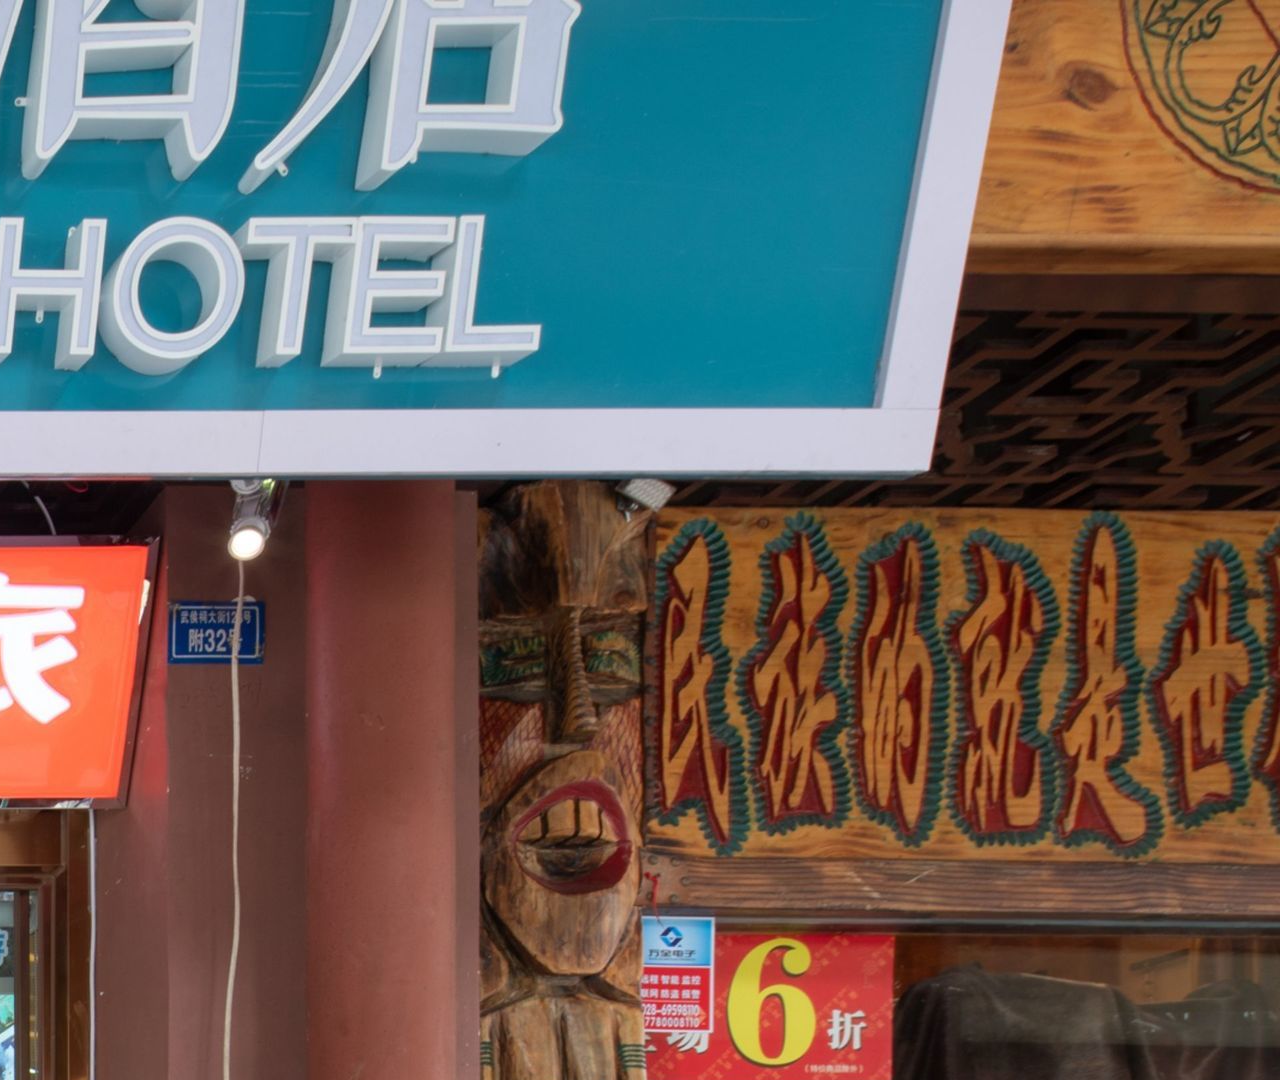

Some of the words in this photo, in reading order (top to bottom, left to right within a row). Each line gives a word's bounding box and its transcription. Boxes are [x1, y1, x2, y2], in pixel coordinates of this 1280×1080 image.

[656, 518, 1280, 847] 民族的就是世
[827, 1009, 868, 1051] 折
